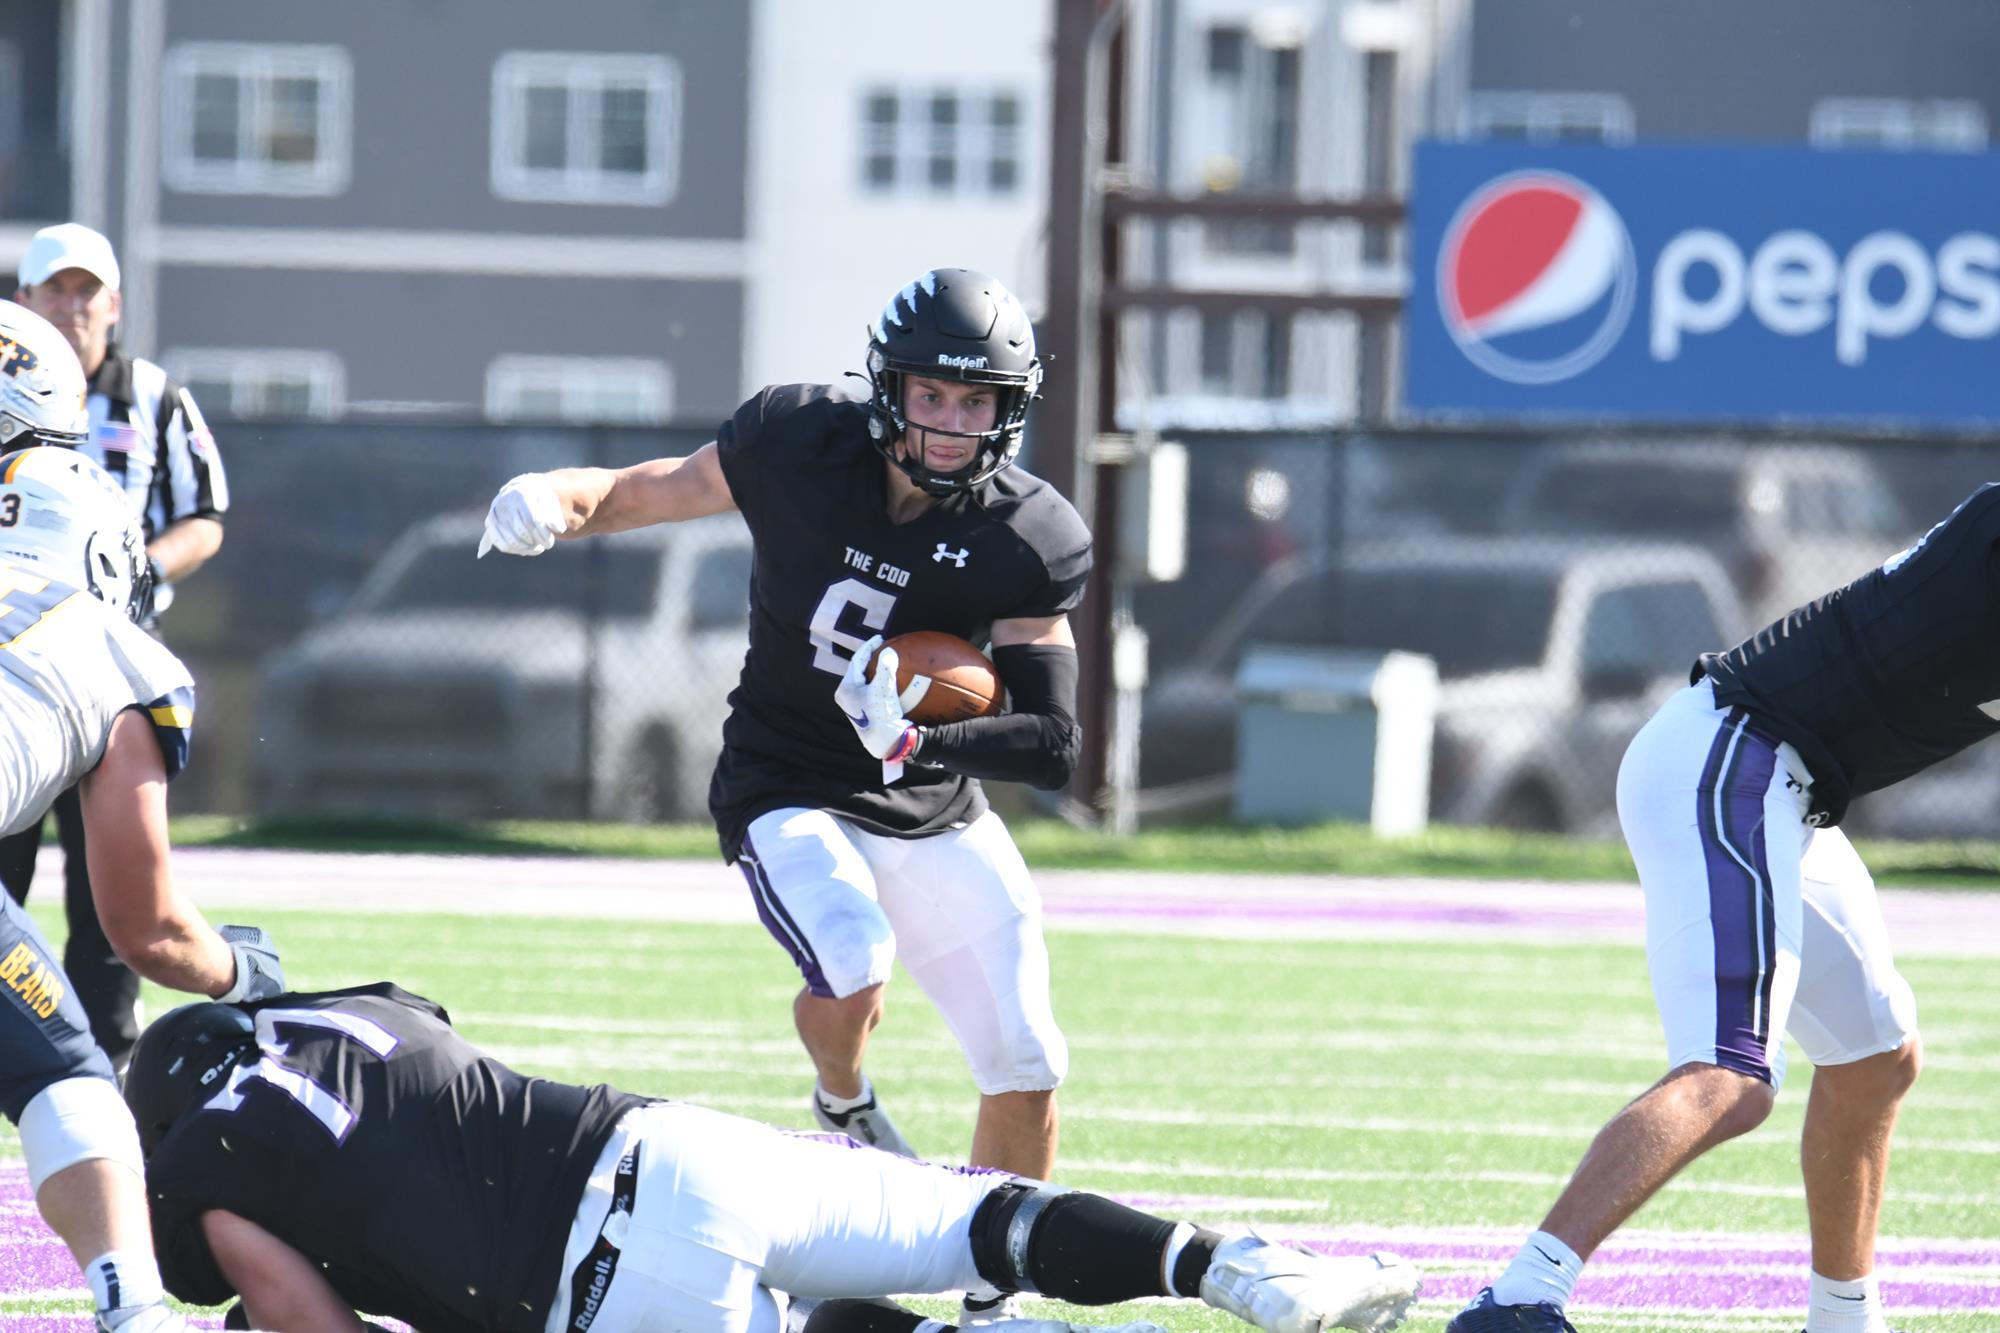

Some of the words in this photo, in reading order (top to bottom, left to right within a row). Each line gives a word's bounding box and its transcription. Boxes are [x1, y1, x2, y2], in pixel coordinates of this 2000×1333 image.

[938, 354, 984, 369] Riddell
[844, 546, 873, 573] THE
[0, 942, 64, 1019] BEARS
[574, 1259, 613, 1331] Riddell
